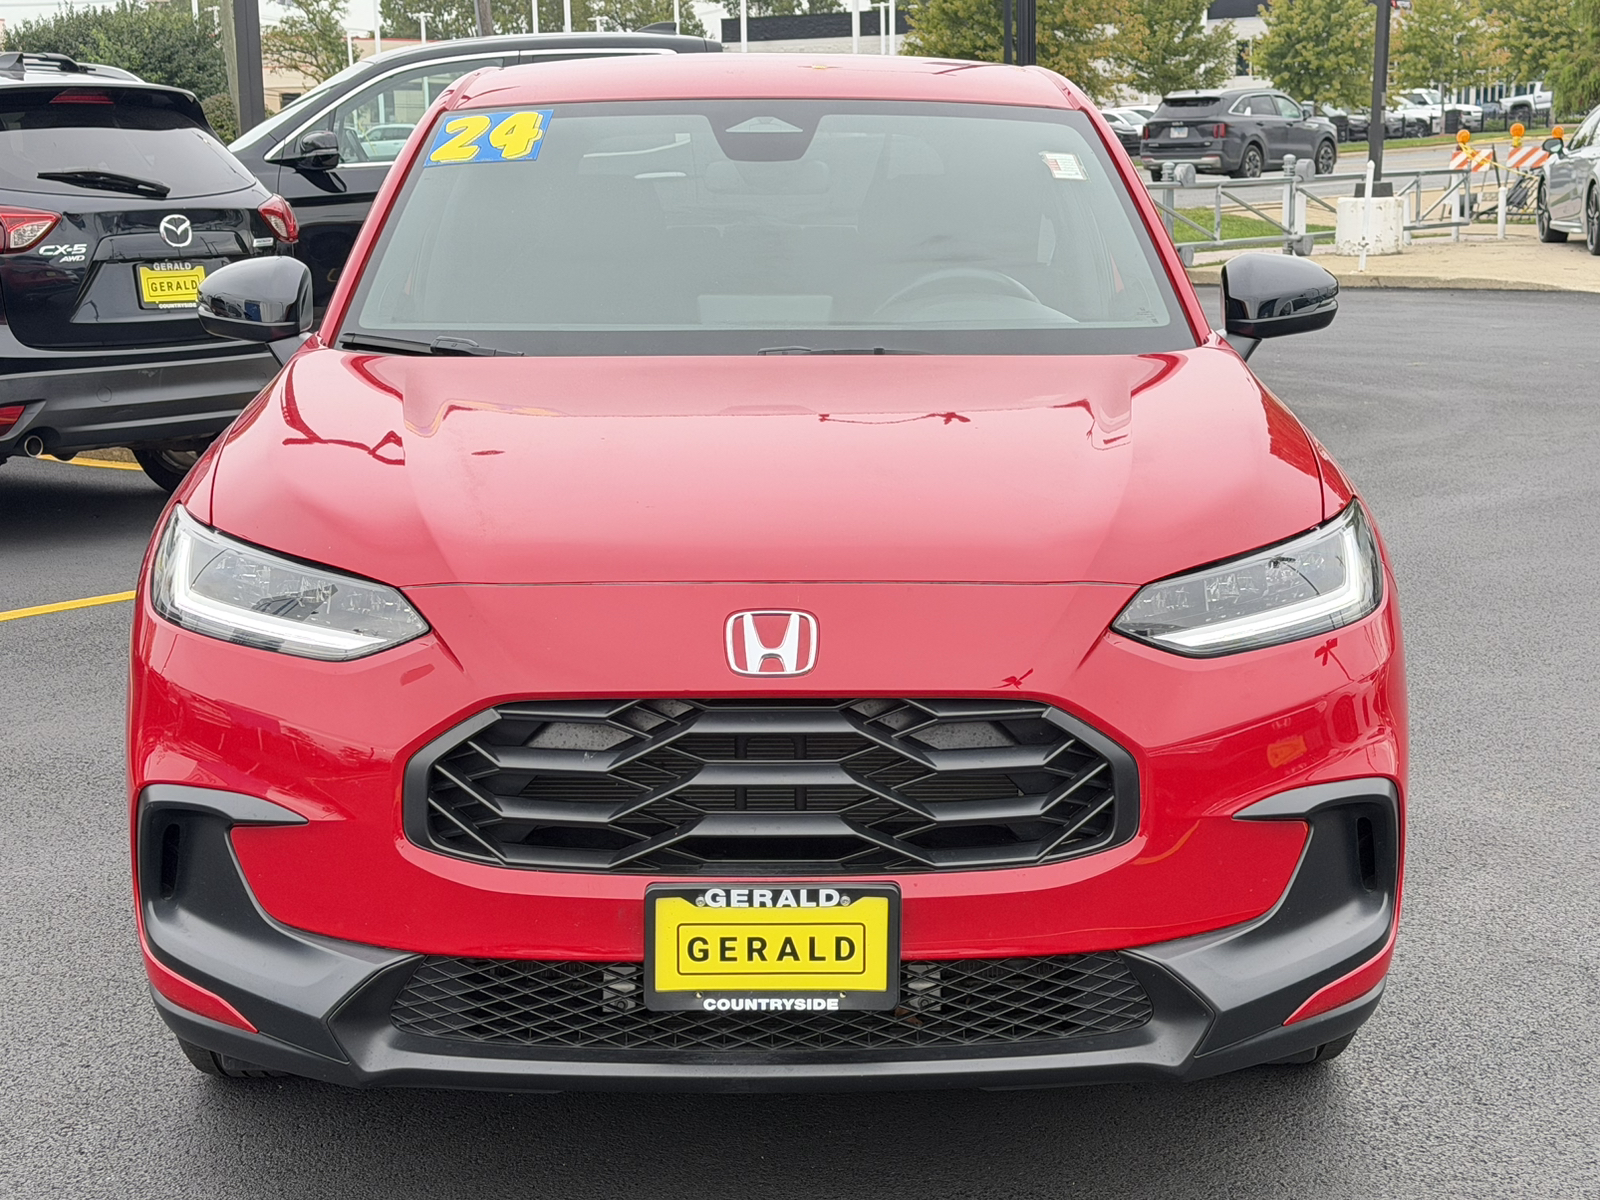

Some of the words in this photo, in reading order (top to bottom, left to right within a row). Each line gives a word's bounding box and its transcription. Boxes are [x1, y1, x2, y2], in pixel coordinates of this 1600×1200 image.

[429, 111, 543, 163] 24
[39, 244, 87, 255] CX-5
[59, 255, 85, 263] AWD
[153, 262, 191, 271] GERALD
[150, 280, 198, 292] GERALD
[704, 888, 840, 908] GERALD
[687, 936, 856, 962] GERALD
[703, 998, 839, 1011] COUNTRYSIDE
